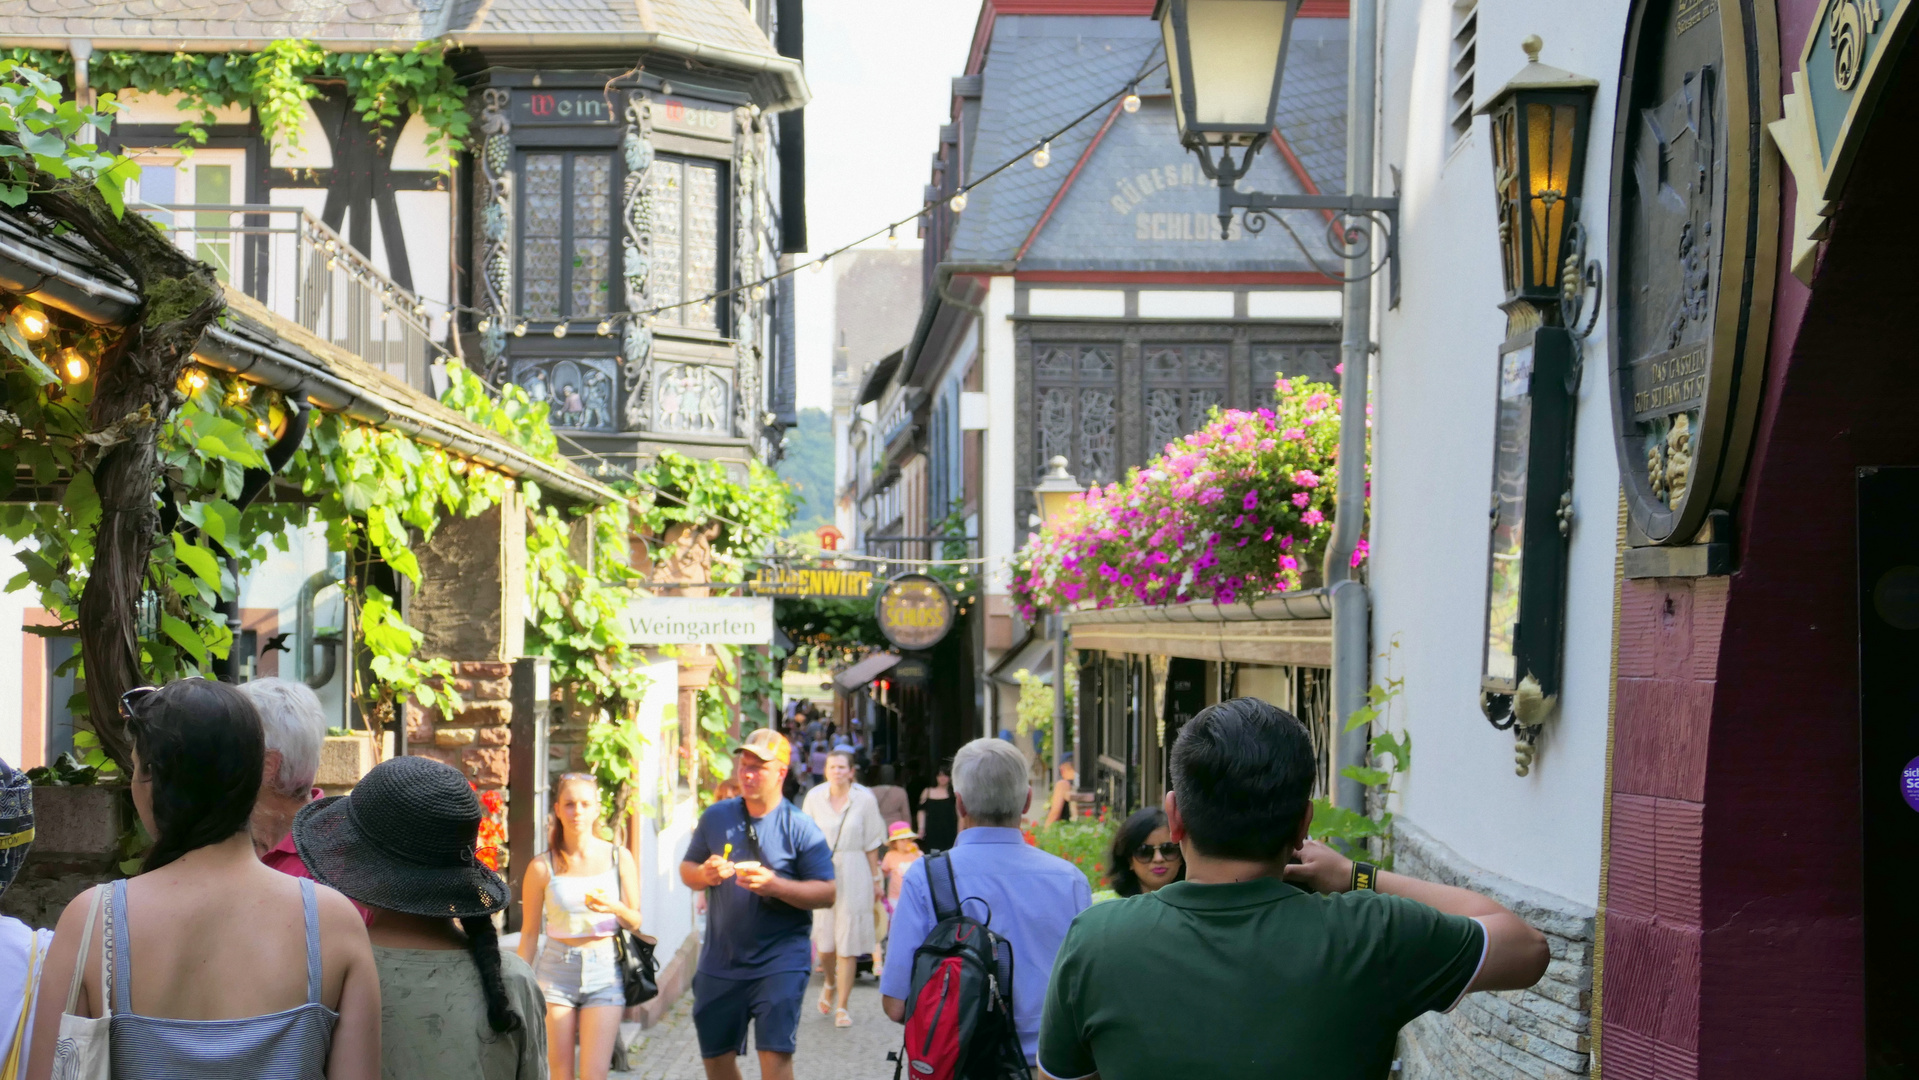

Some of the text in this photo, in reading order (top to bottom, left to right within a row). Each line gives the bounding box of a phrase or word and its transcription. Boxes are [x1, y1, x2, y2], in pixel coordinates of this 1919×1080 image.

[1652, 361, 1668, 384] DAS
[1664, 381, 1682, 407] DANK
[1683, 378, 1695, 400] IST
[629, 616, 756, 641] Weingarten
